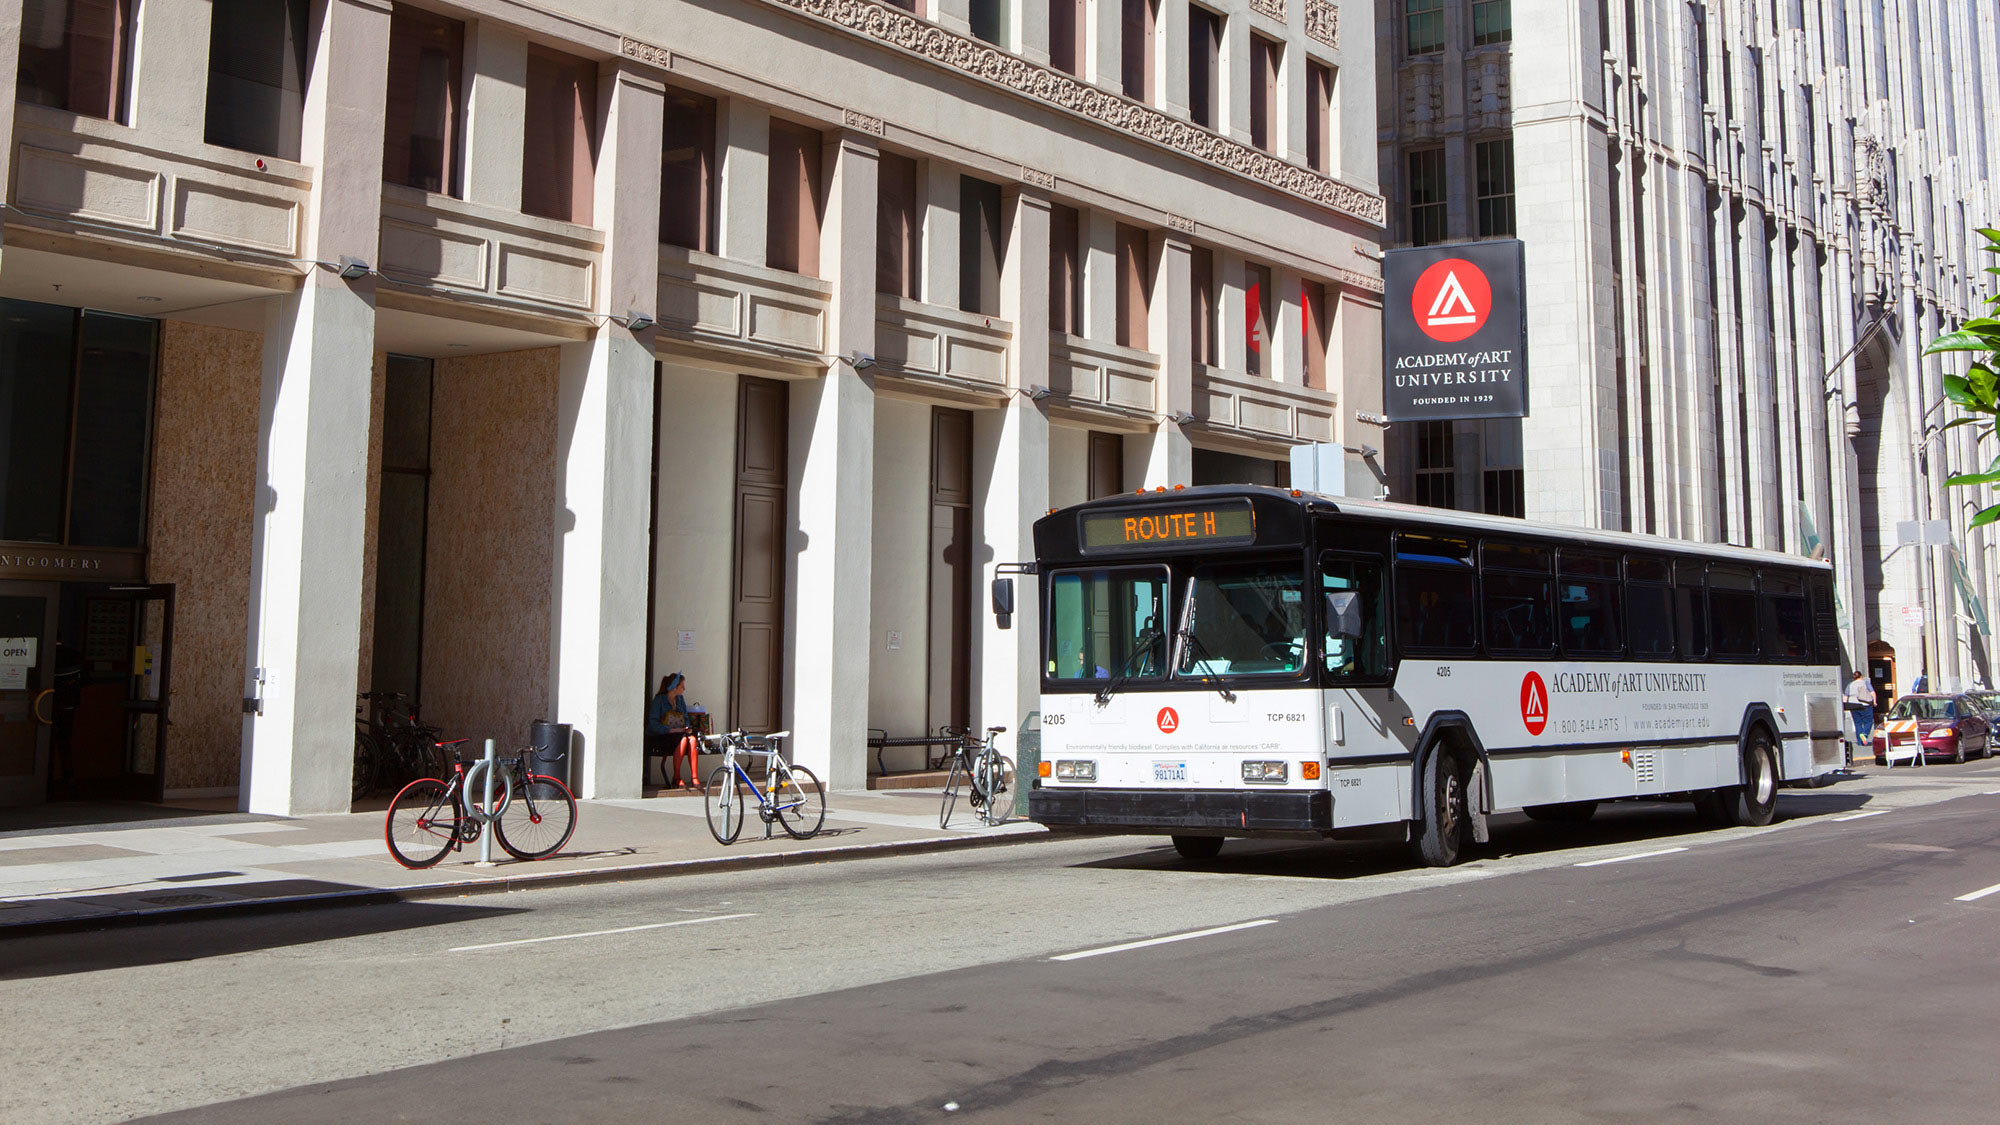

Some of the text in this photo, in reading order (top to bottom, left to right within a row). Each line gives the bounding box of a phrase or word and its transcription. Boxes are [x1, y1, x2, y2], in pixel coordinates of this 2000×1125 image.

[1395, 350, 1512, 368] ACADEMY of ART
[1396, 369, 1512, 387] UNIVERSITY
[1413, 394, 1494, 405] FOUNDED IN 1929
[1124, 511, 1216, 541] ROUTE H
[3, 648, 28, 657] OPEN
[1436, 666, 1451, 677] 4205
[1552, 672, 1706, 699] ACADEMY of ART UNIVERSITY
[1043, 714, 1066, 725] 4205
[1267, 713, 1306, 722] TCP 6821
[1632, 715, 1711, 731] www.academyart.edu
[1340, 779, 1350, 788] TCP
